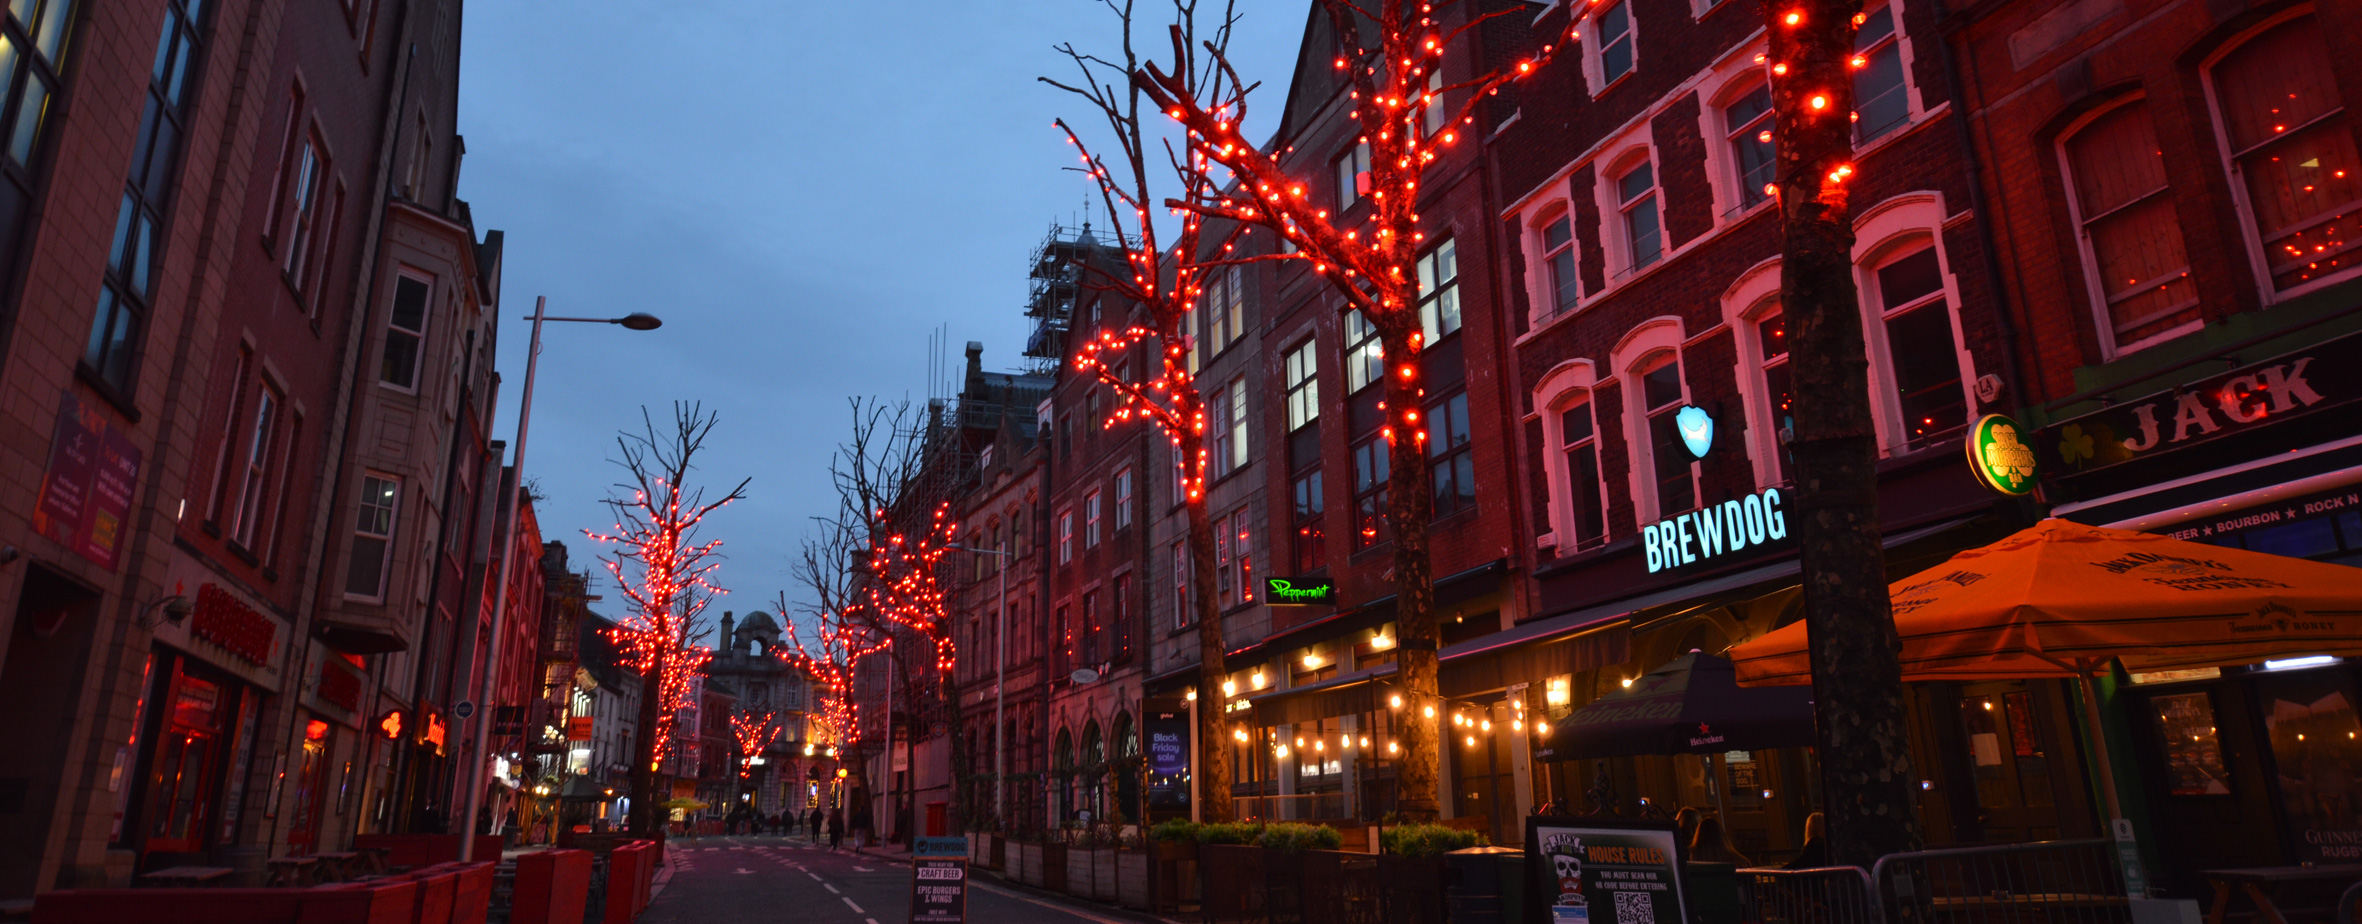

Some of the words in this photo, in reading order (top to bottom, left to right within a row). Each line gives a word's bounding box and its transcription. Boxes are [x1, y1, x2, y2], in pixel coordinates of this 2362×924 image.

[2123, 356, 2327, 452] JACK
[1993, 431, 2019, 449] JACK
[2009, 473, 2023, 483] BAR
[2216, 510, 2281, 533] BOURBON
[2304, 497, 2346, 515] ROCK
[2347, 493, 2360, 506] N
[1643, 487, 1787, 574] BREWDOG
[1269, 579, 1331, 602] Peppermint
[2292, 621, 2335, 631] HONEY
[1153, 733, 1178, 743] Black
[1689, 734, 1725, 747] Heineken
[1152, 743, 1180, 754] Friday
[1157, 752, 1176, 762] sale
[1554, 835, 1576, 846] JACK
[929, 842, 966, 852] BREWDOG
[1587, 846, 1627, 864] HOUSE
[1628, 848, 1665, 864] RULES
[921, 869, 943, 878] CRAFT
[943, 869, 960, 878] BEER
[1600, 871, 1612, 879] YOU
[1613, 871, 1629, 880] MUST
[1630, 872, 1645, 880] SCAN
[1646, 872, 1658, 881] OUR
[917, 886, 932, 894] EPIC
[932, 886, 961, 895] BURGERS
[1604, 881, 1618, 890] CODE
[1619, 882, 1640, 890] BEFORE
[1640, 882, 1668, 891] ENTERING
[931, 895, 953, 903] WINGS
